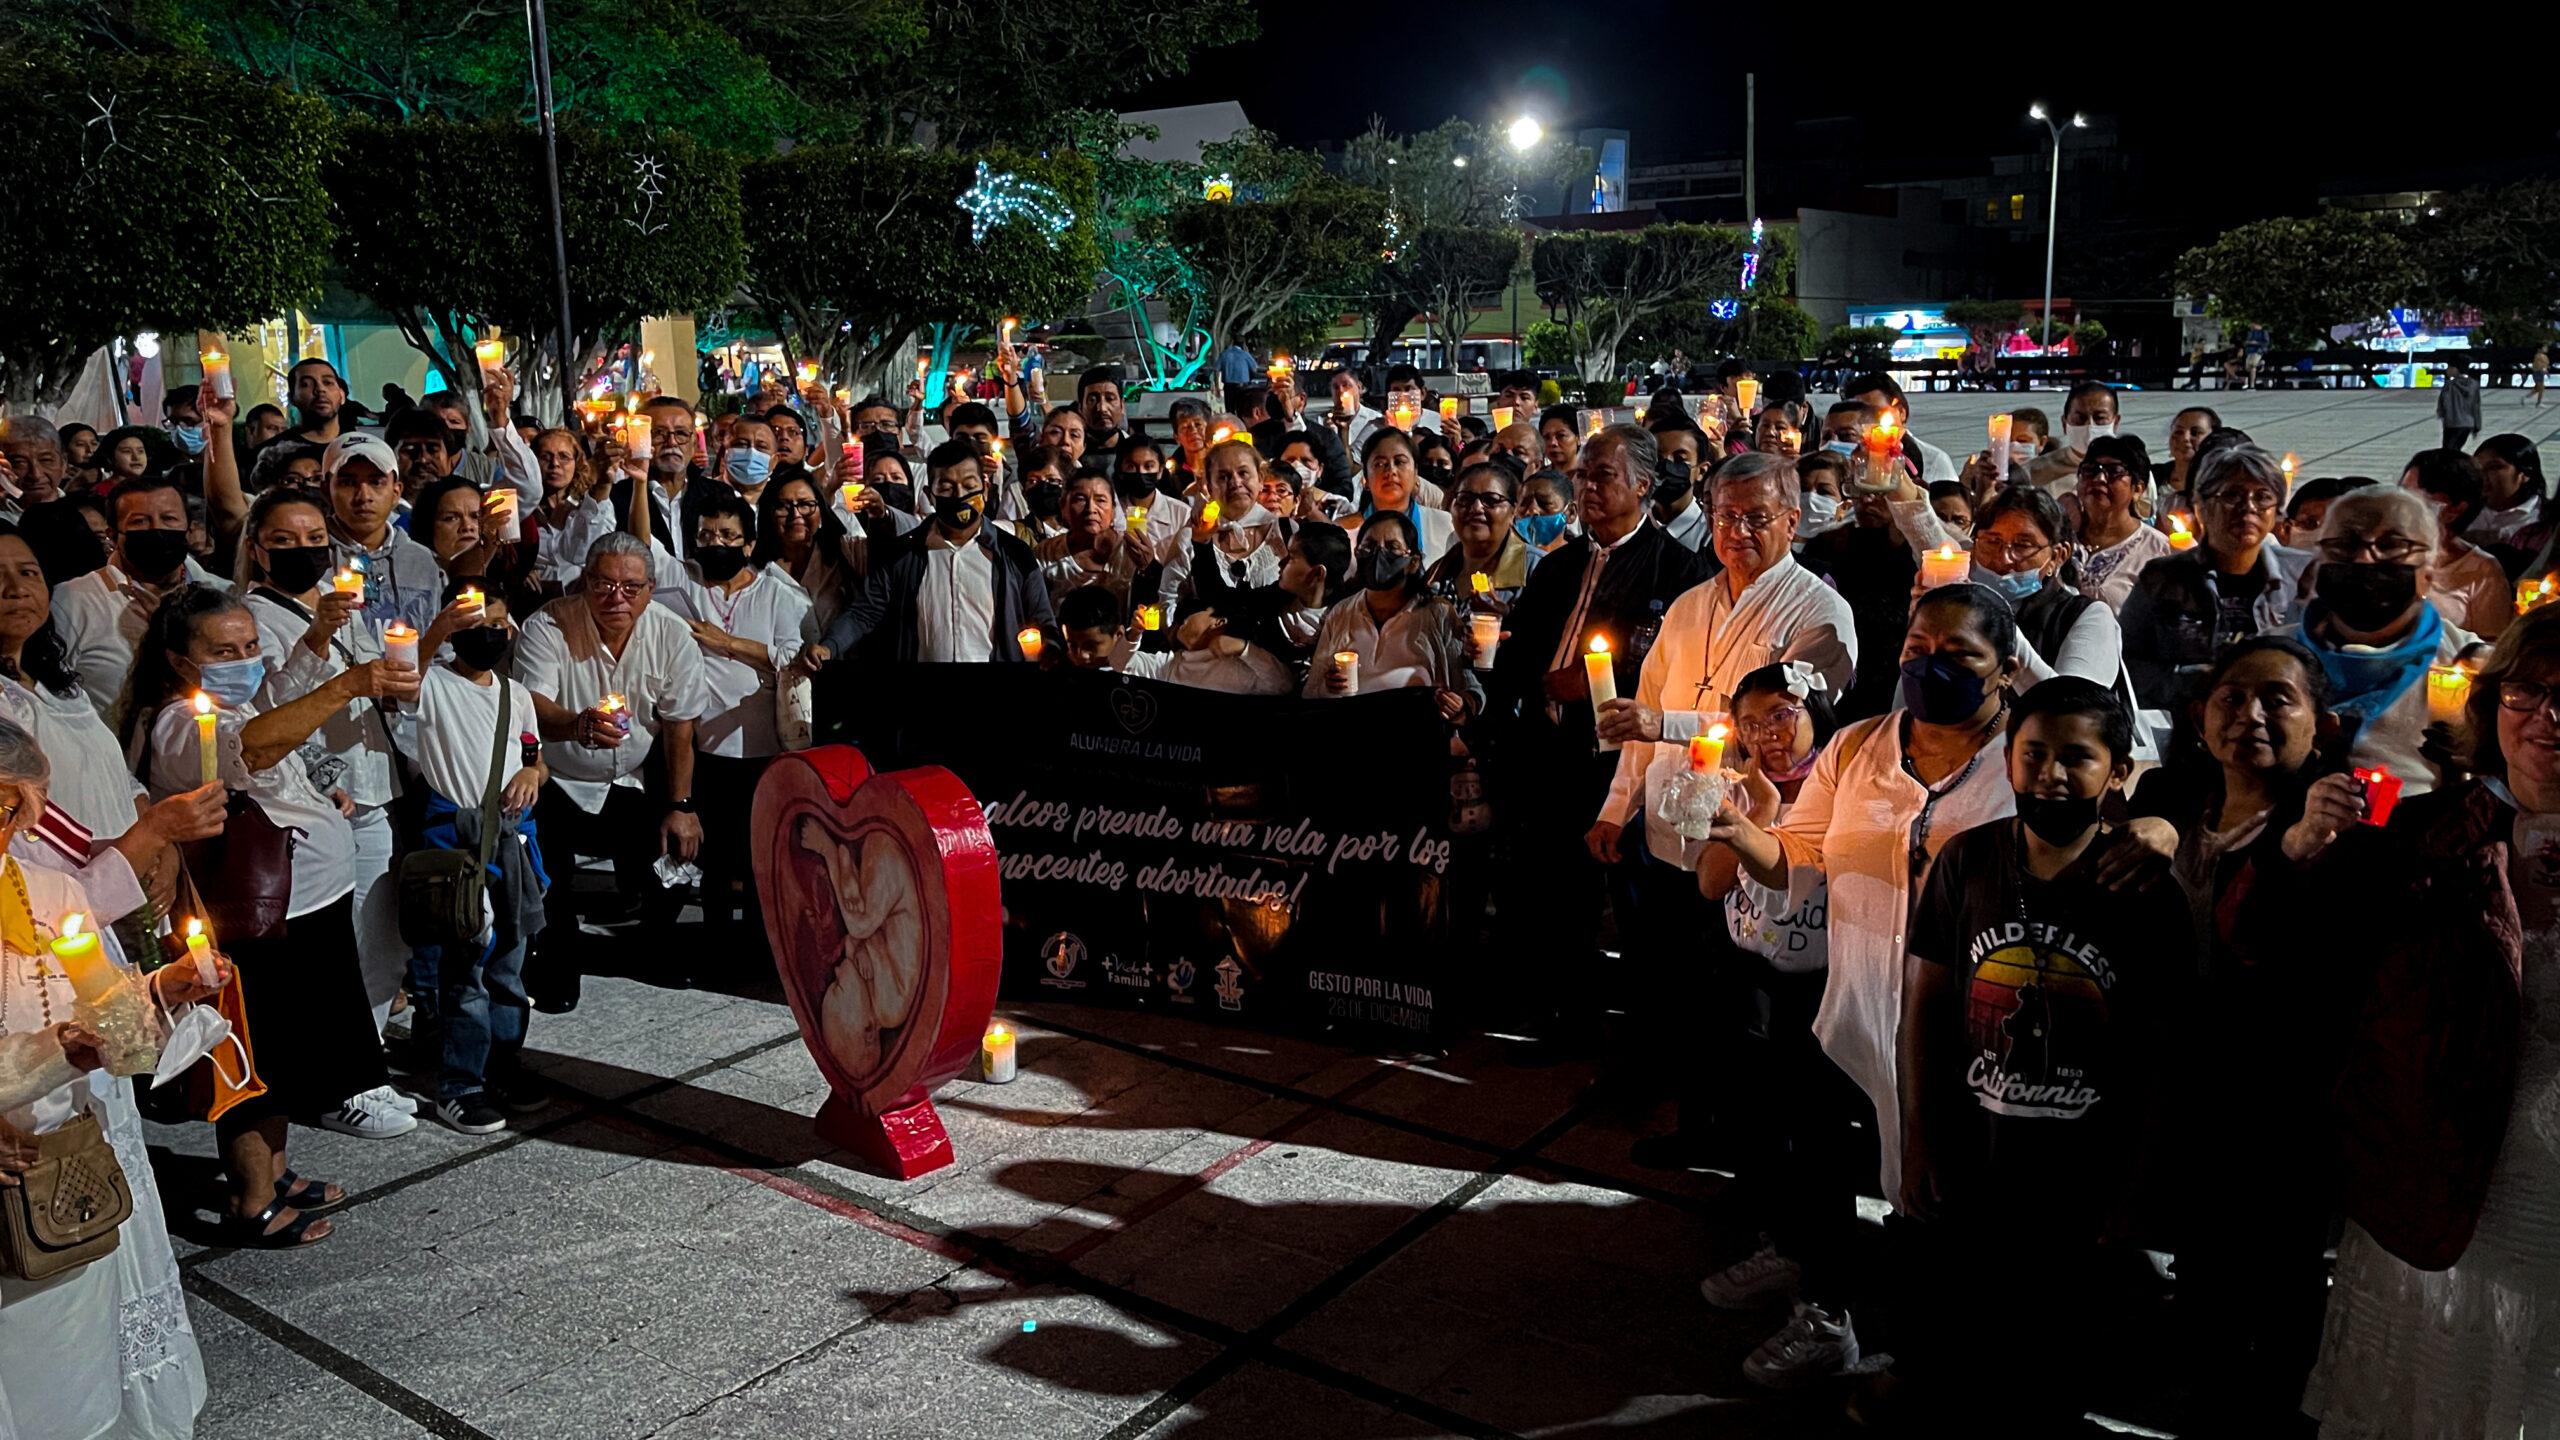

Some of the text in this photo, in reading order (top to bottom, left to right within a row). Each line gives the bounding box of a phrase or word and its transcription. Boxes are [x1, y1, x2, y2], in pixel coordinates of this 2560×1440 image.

[1069, 731, 1202, 764] ALUMBRA LA VIDA
[1072, 804, 1184, 844] prende
[1191, 818, 1255, 848] una
[1260, 818, 1328, 857] vela
[1327, 833, 1400, 876] por
[1408, 826, 1450, 874] los
[997, 849, 1309, 913] nocentes abortados!
[1107, 972, 1151, 988] Familia
[1308, 970, 1433, 1010] GESTO POR LA VIDA
[1327, 996, 1433, 1033] 28 DE DICIEMBRE
[1966, 1055, 2102, 1107] California
